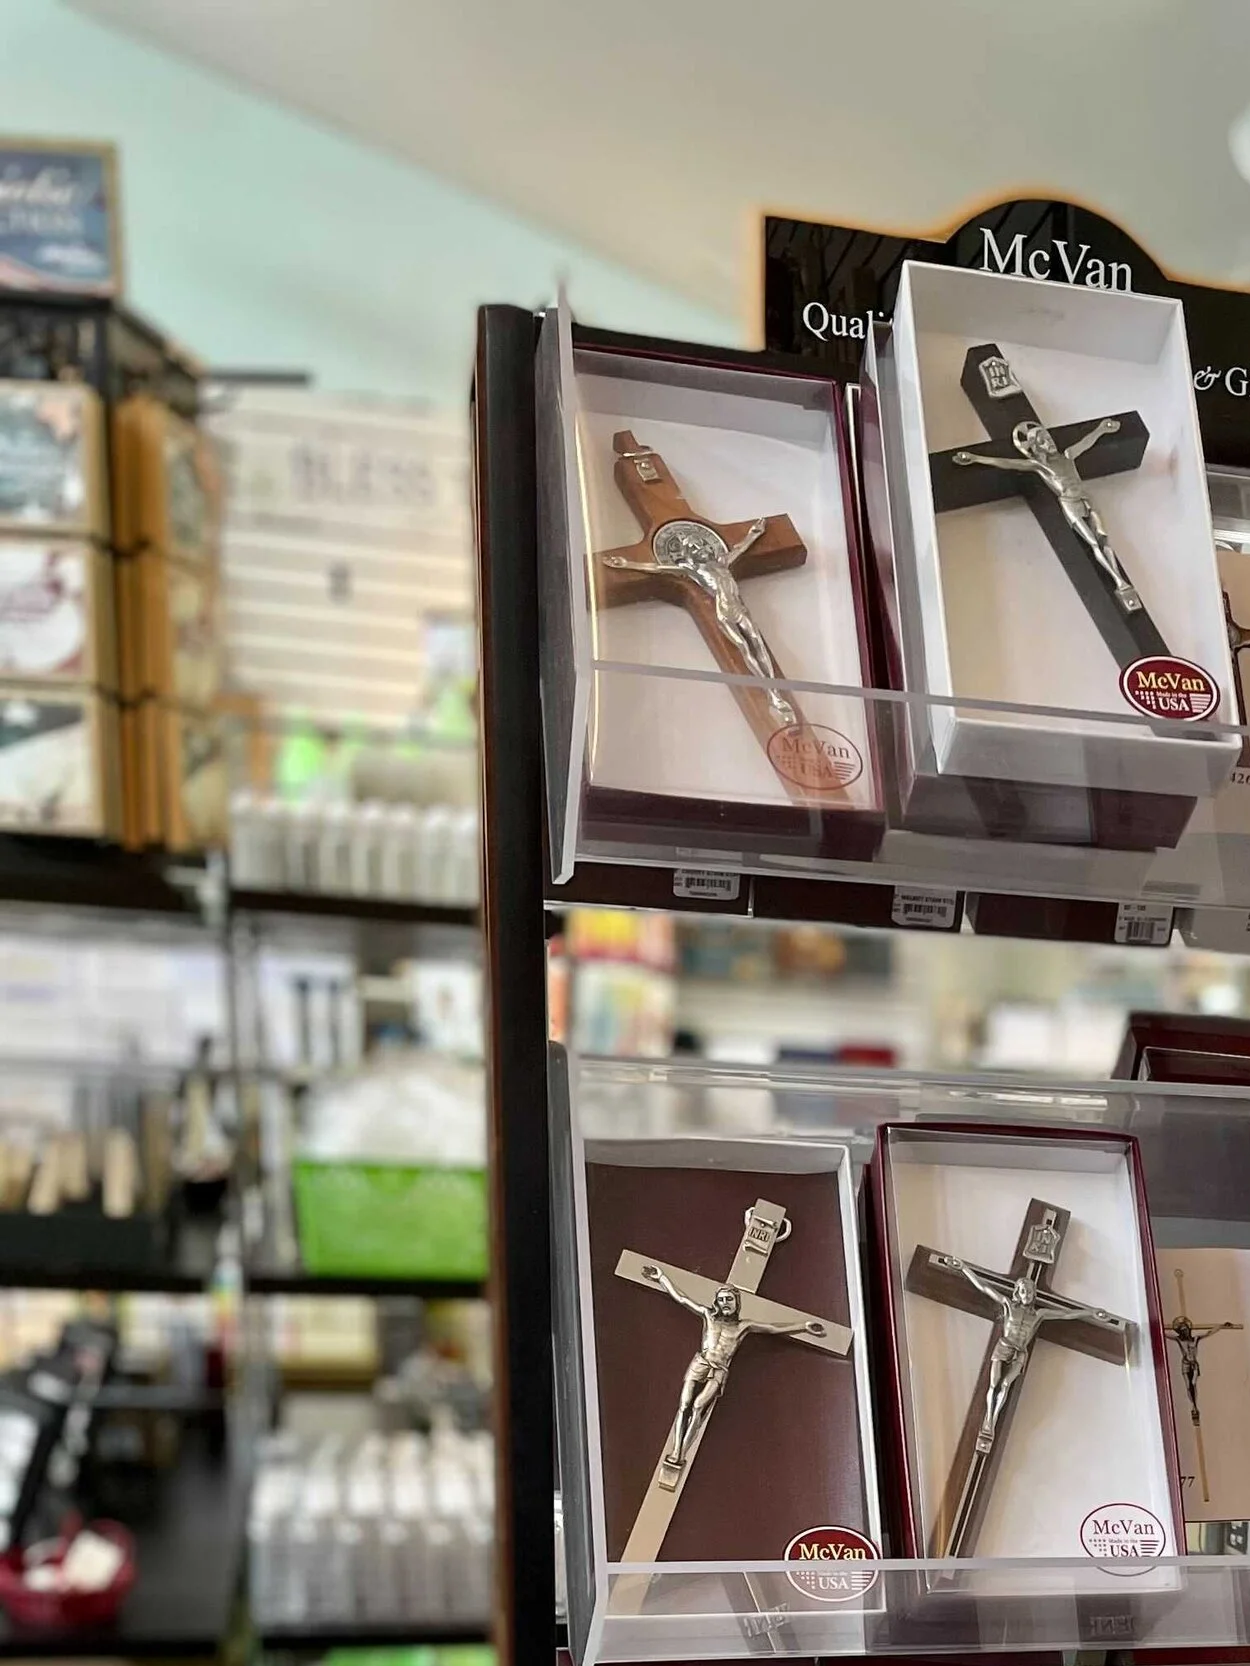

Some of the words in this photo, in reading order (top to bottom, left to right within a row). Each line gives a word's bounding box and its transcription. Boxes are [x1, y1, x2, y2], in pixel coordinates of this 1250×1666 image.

[979, 227, 1132, 293] McVan
[1194, 366, 1221, 391] &
[1136, 671, 1205, 691] McVan
[1158, 697, 1190, 711] USA
[783, 737, 850, 759] McVan
[749, 1227, 771, 1243] INRI
[1092, 1519, 1156, 1536] McVan
[799, 1543, 867, 1561] McVan
[1110, 1544, 1139, 1558] USA
[818, 1576, 849, 1590] USA
